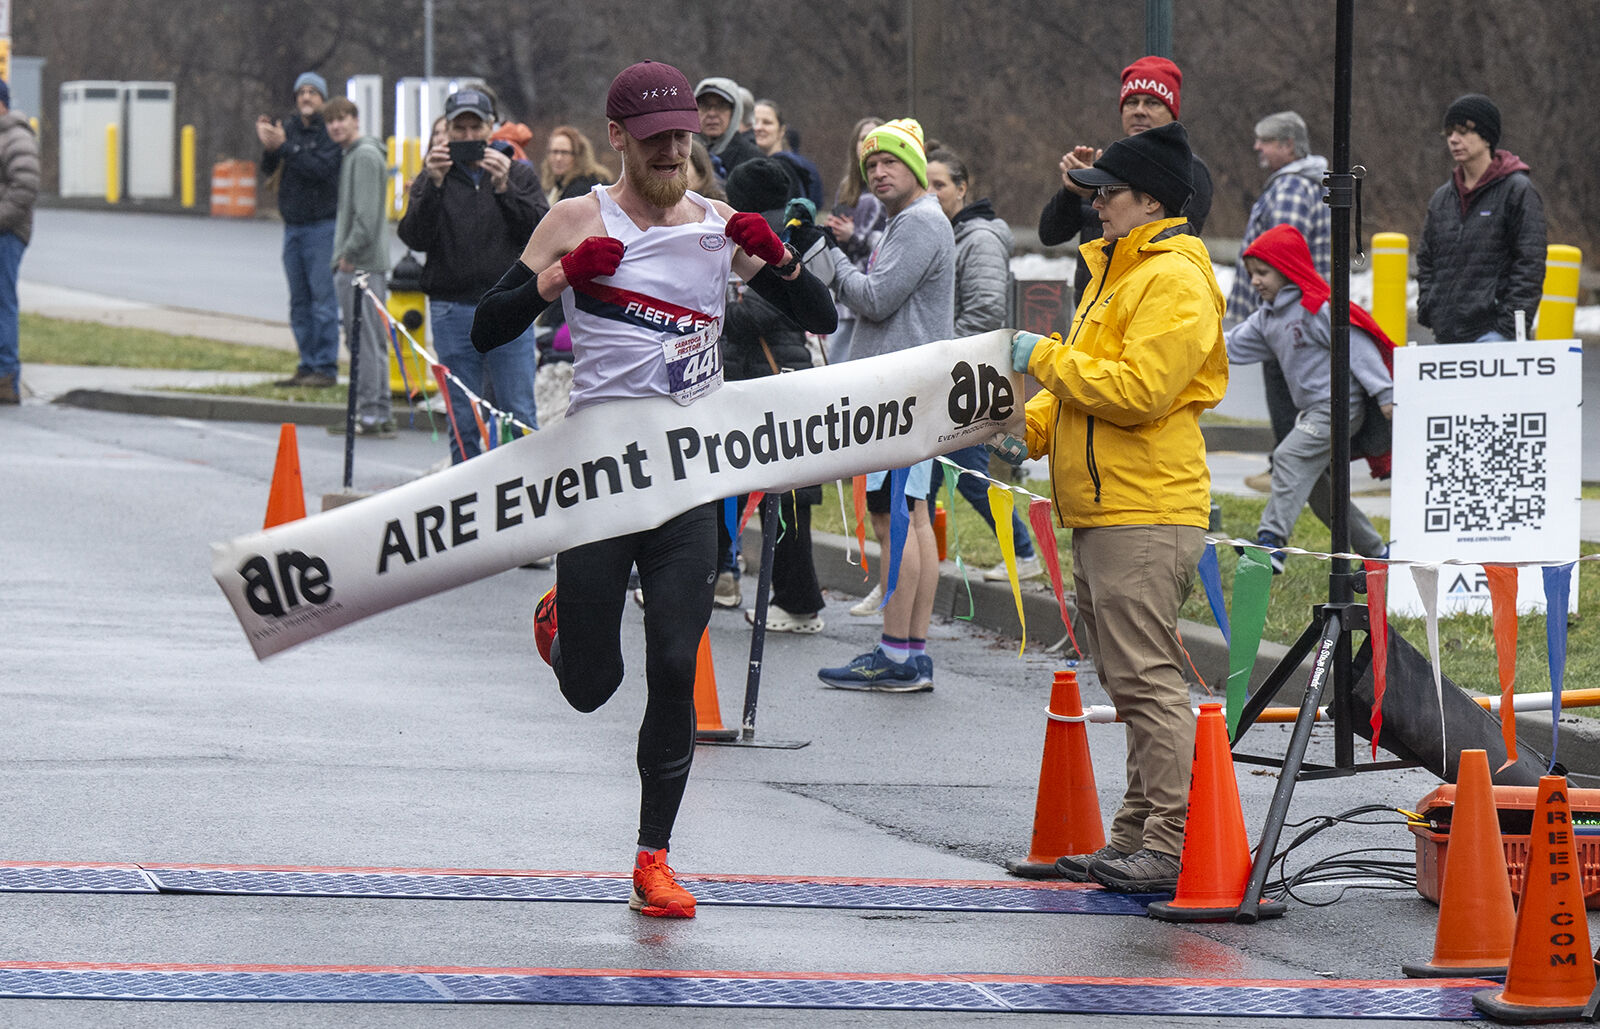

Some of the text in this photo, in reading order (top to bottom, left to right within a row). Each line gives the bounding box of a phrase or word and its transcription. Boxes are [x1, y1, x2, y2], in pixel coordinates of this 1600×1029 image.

[1121, 79, 1174, 105] CANADA
[625, 302, 674, 326] FLEET
[683, 343, 719, 383] 441
[1418, 357, 1557, 381] RESULTS
[947, 360, 1014, 428] are
[376, 396, 918, 576] ARE Event Productions
[1546, 791, 1577, 967] AREEP.COM
